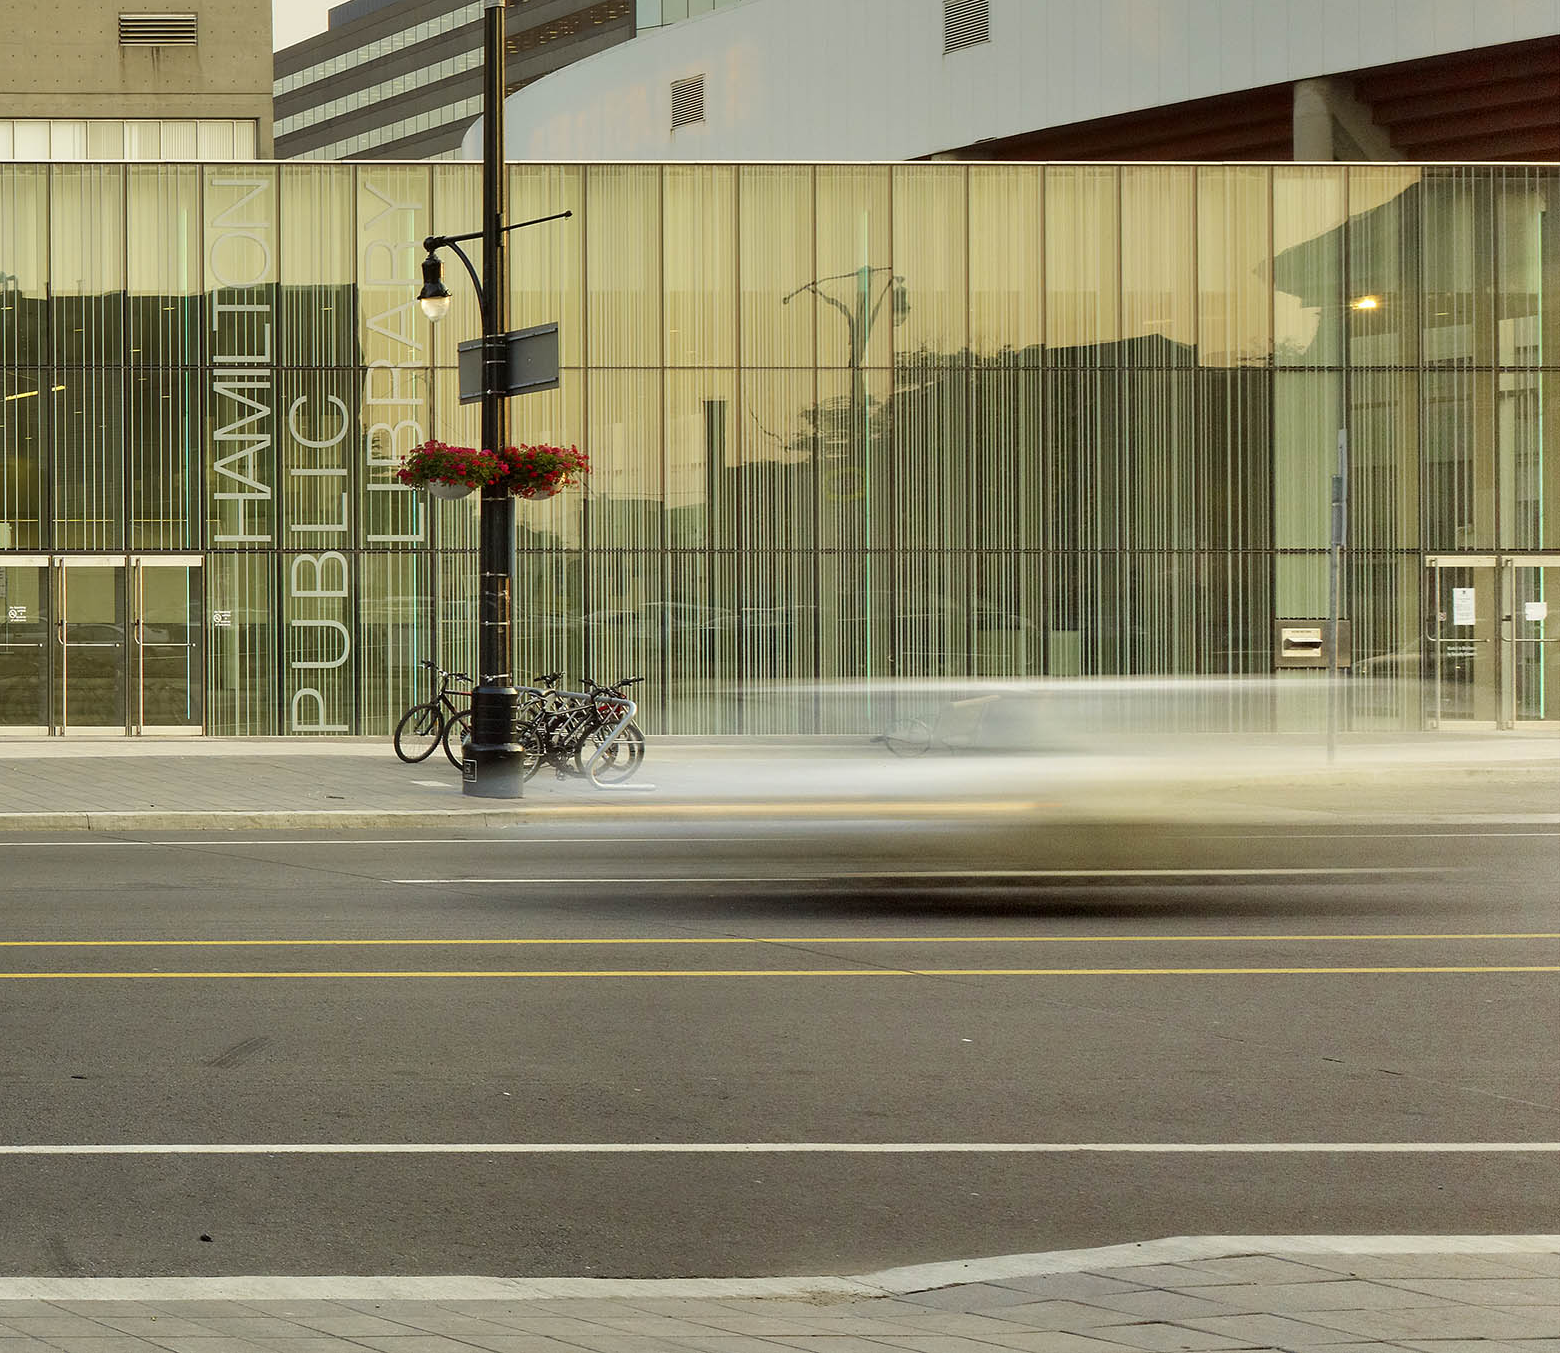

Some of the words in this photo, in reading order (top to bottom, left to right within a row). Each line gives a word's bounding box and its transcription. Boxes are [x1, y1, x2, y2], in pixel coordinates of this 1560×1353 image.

[211, 178, 272, 543] HAMILTON
[364, 180, 425, 543] LIBRARY
[289, 394, 351, 732] PUBLIC
